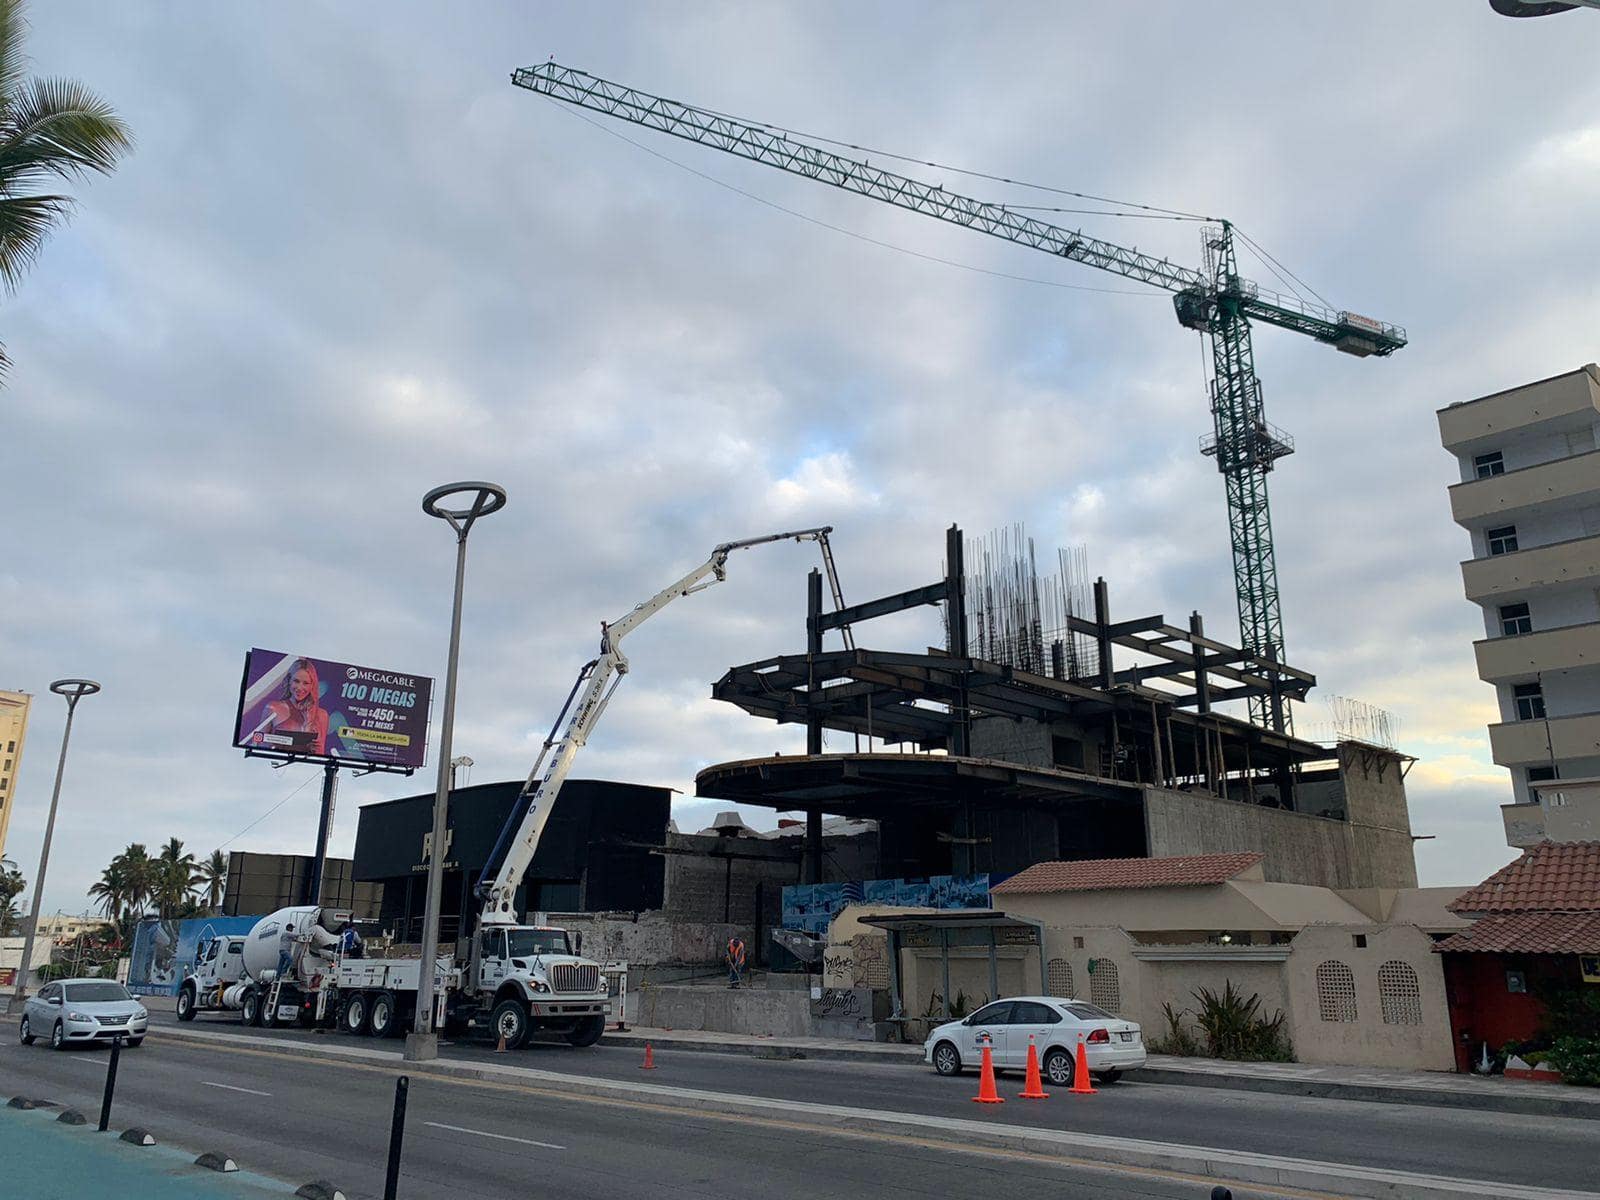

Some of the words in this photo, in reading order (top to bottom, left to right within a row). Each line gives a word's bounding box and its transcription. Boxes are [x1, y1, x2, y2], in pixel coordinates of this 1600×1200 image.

[358, 670, 415, 687] MEGACABLE
[341, 682, 368, 700] 100
[369, 686, 416, 708] MEGAS
[367, 720, 373, 728] 12
[374, 722, 395, 731] MESES
